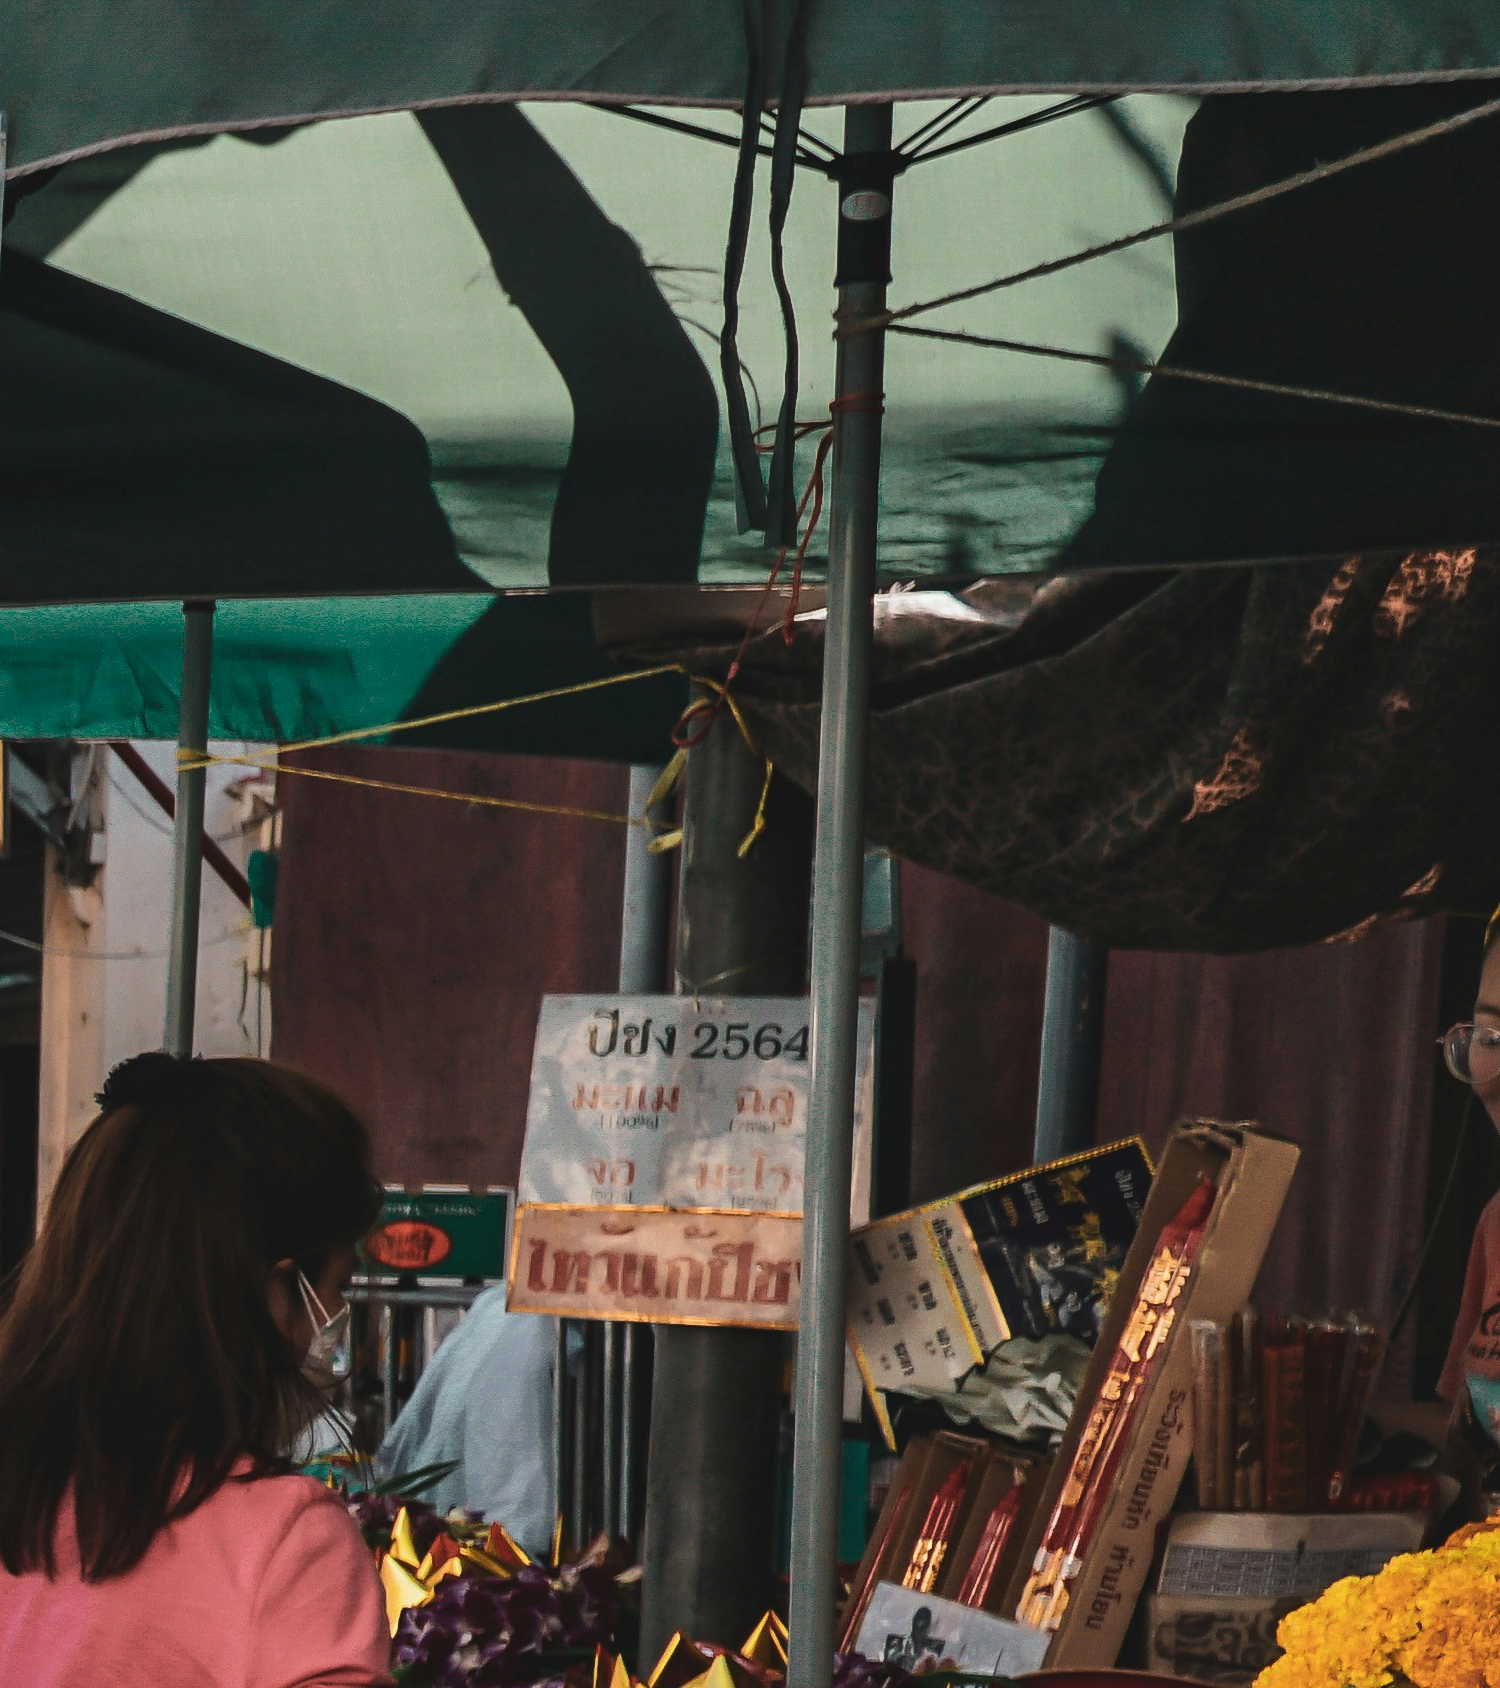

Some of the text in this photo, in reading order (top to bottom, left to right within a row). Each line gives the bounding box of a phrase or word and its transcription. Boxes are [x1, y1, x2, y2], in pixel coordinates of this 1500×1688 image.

[588, 1007, 810, 1061] ปีชง 2564
[695, 1149, 804, 1195] มะโร
[526, 1217, 802, 1306] ไหว้แก้ปีช
